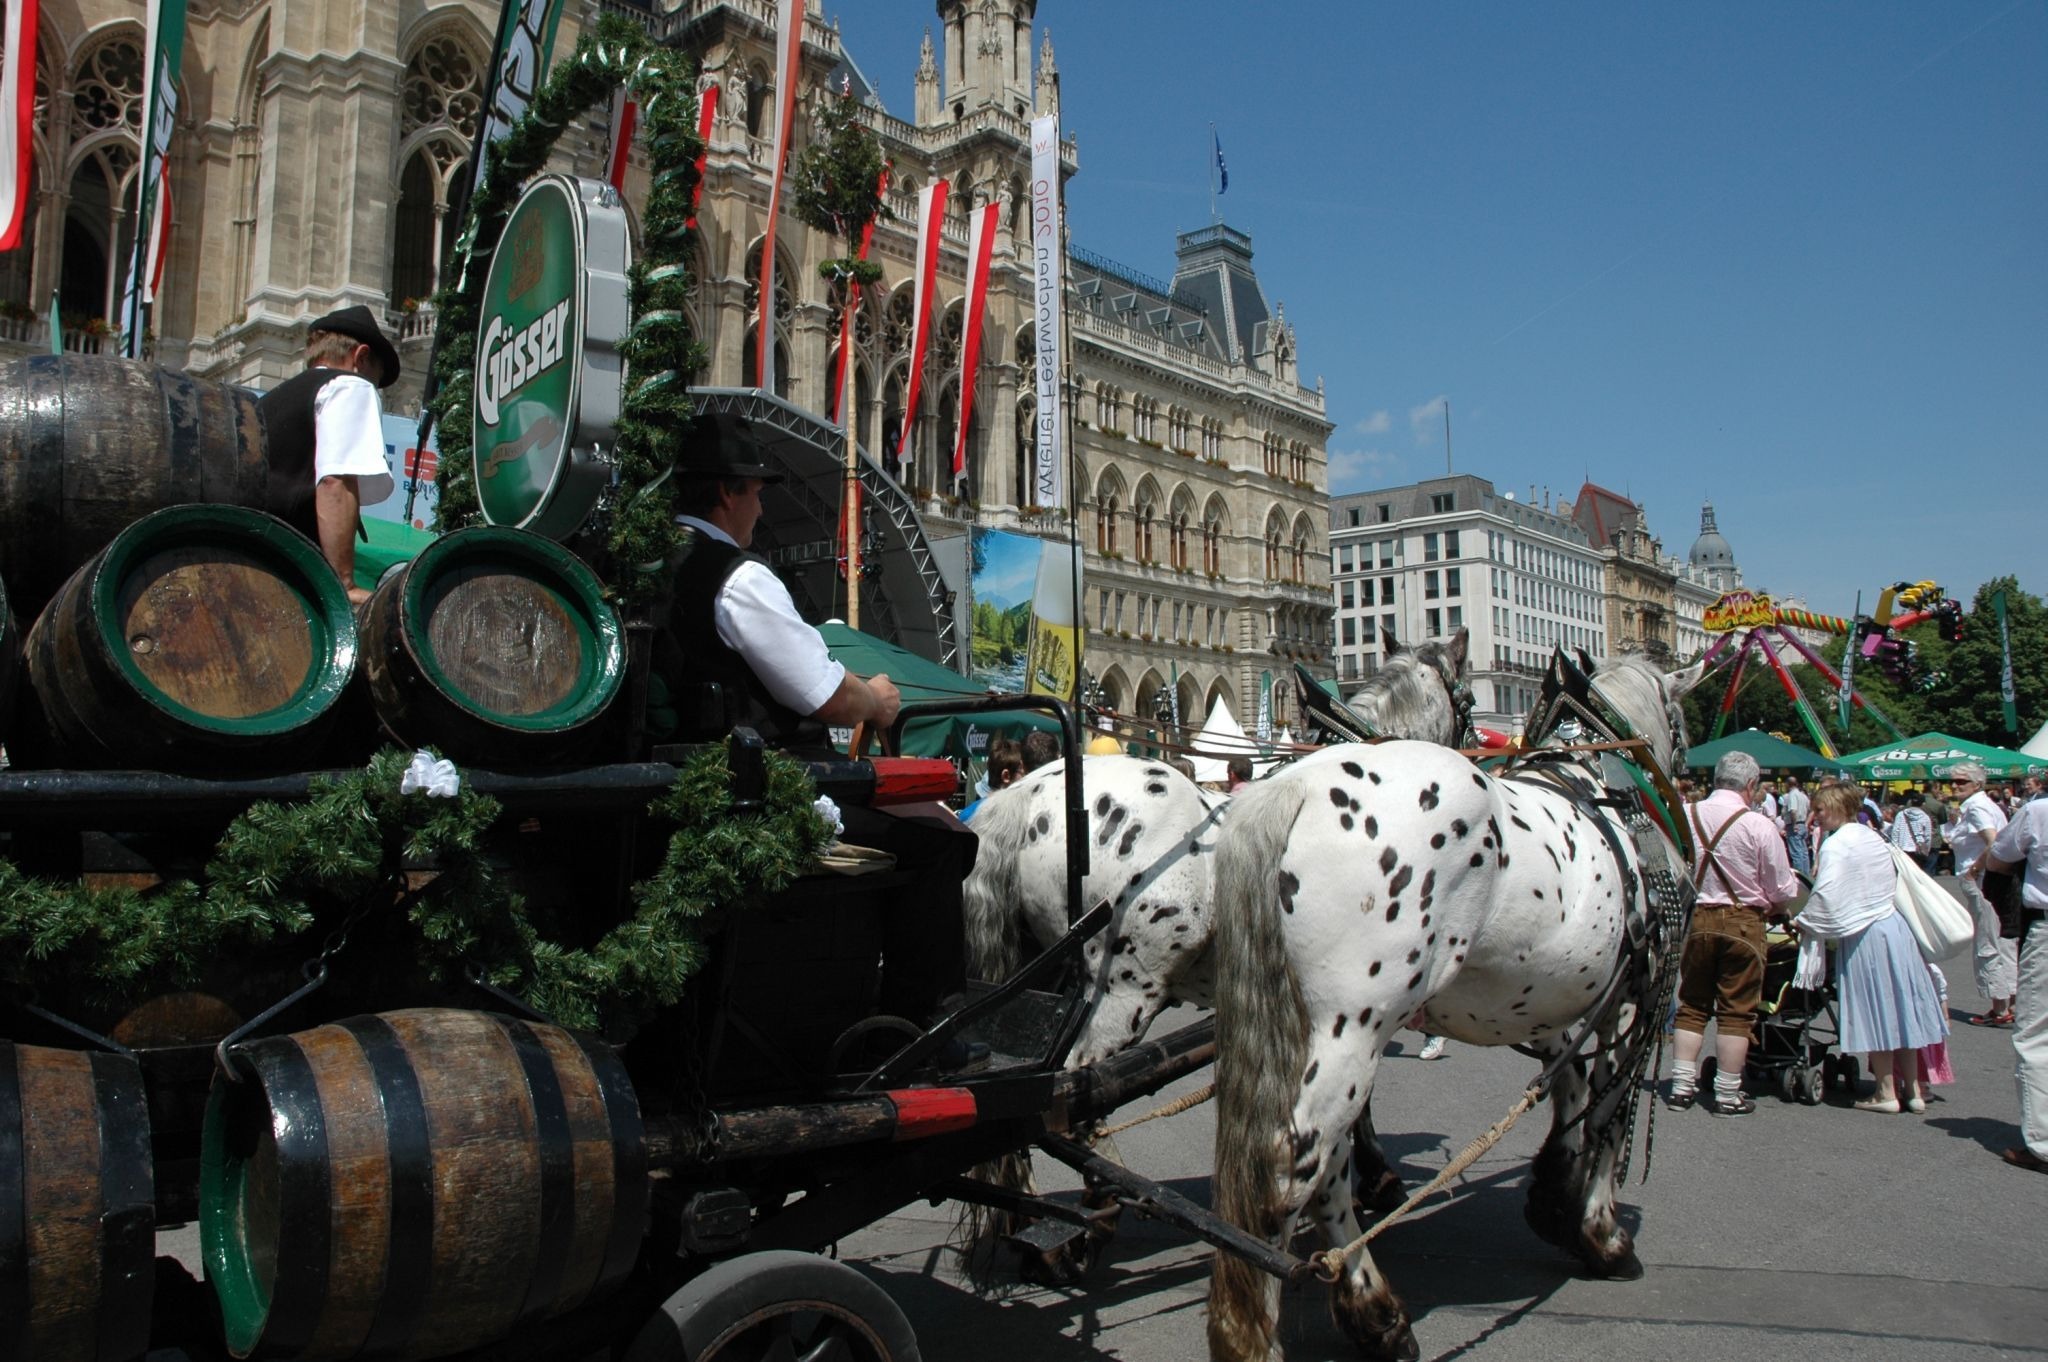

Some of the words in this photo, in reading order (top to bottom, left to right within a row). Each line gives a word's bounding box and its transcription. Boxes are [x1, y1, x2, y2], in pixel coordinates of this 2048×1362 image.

[479, 298, 569, 424] Gösser
[403, 480, 436, 496] BNK
[829, 727, 855, 743] ser
